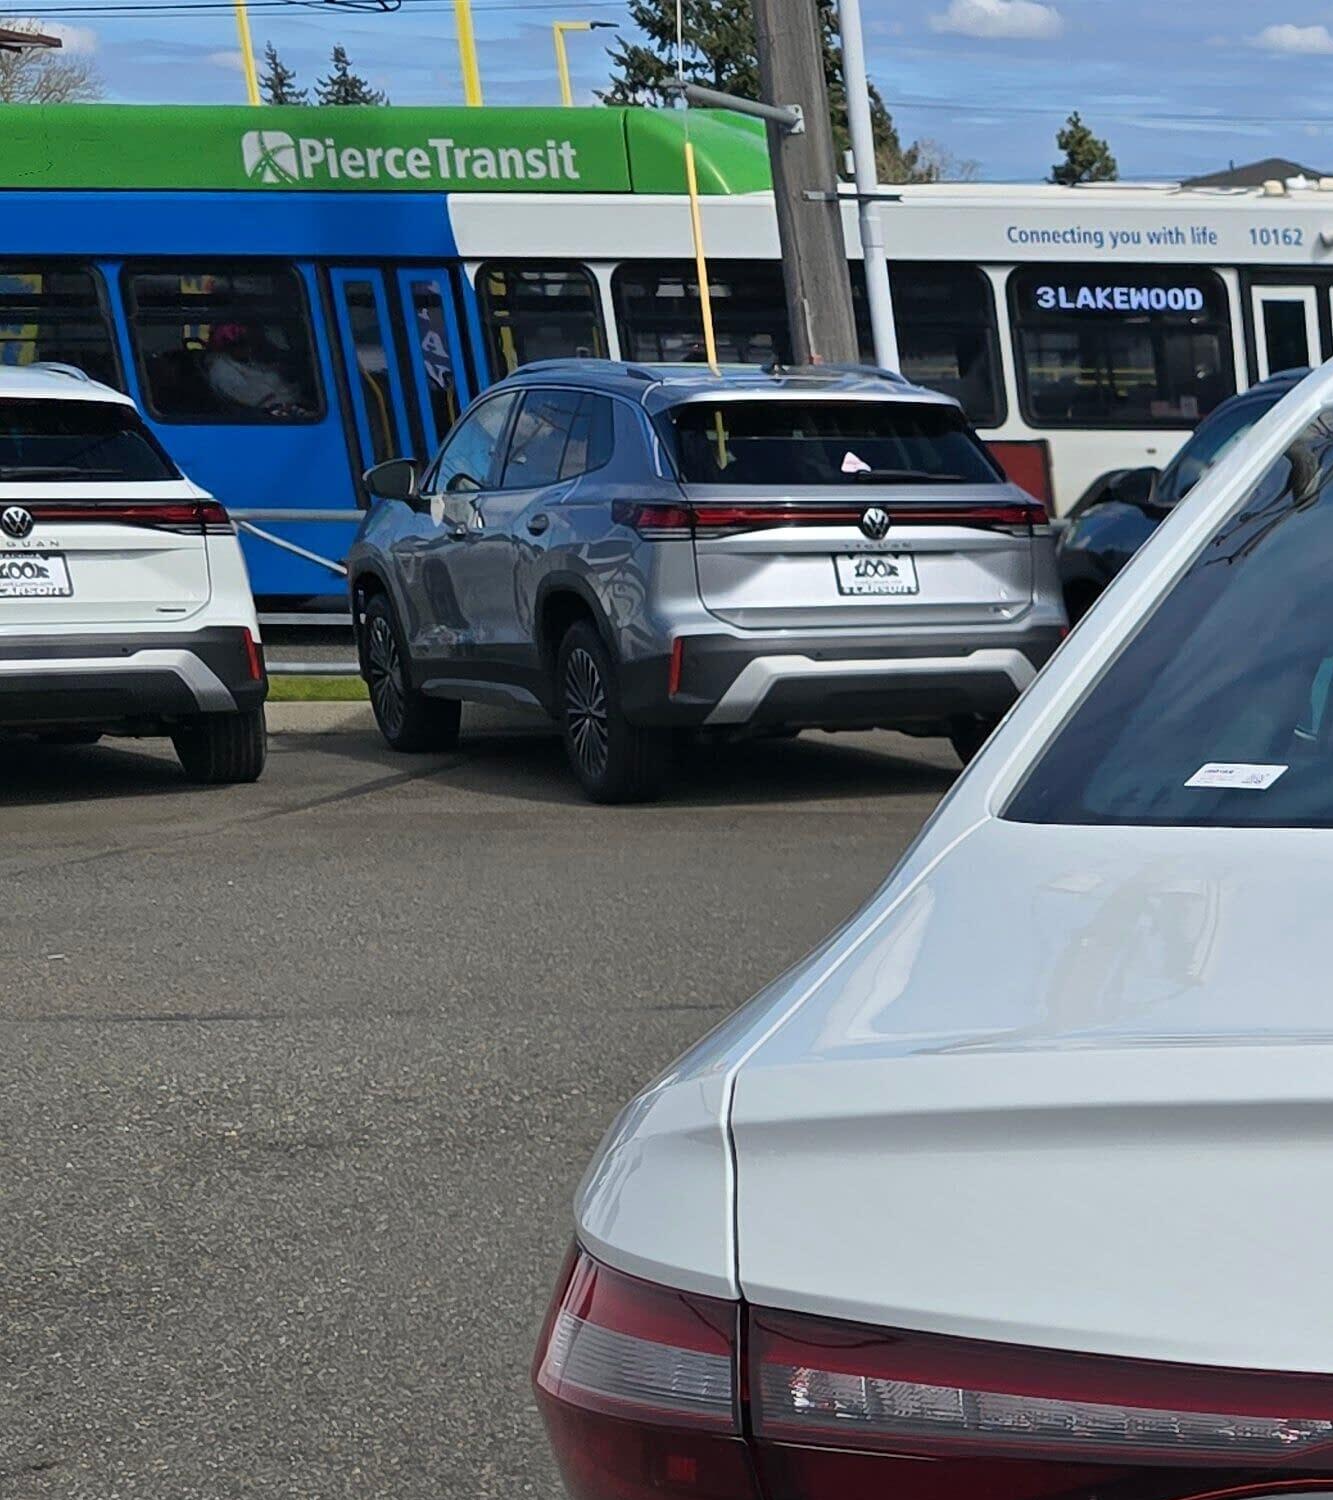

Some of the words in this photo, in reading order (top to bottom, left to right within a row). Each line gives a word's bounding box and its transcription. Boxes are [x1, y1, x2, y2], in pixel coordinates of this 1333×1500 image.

[299, 138, 580, 179] PierceTransit
[1007, 226, 1104, 248] Connecting
[1109, 231, 1142, 249] you
[1146, 227, 1184, 245] with
[1190, 227, 1218, 245] life
[1249, 228, 1303, 246] 10162
